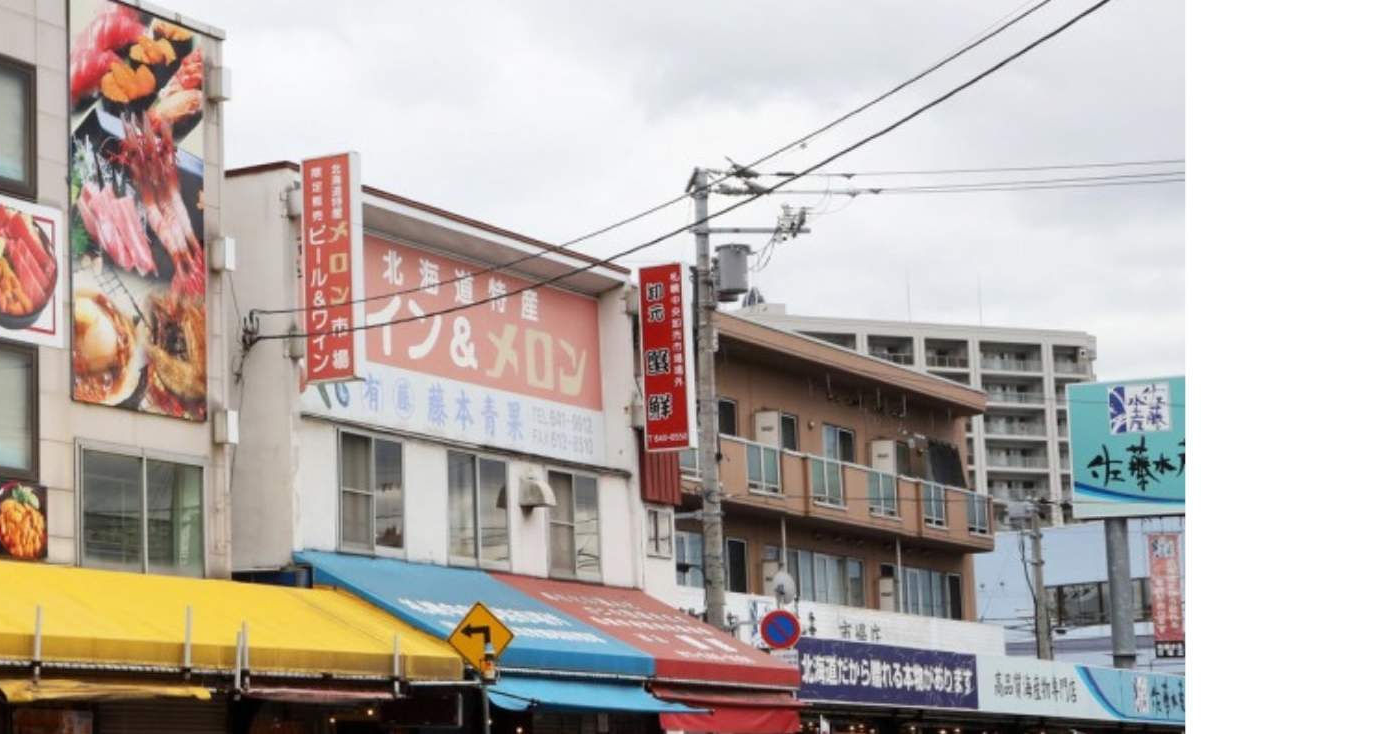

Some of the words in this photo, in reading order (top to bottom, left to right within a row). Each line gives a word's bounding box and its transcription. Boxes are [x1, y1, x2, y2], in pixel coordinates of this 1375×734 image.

[383, 249, 539, 322] 北海道特産
